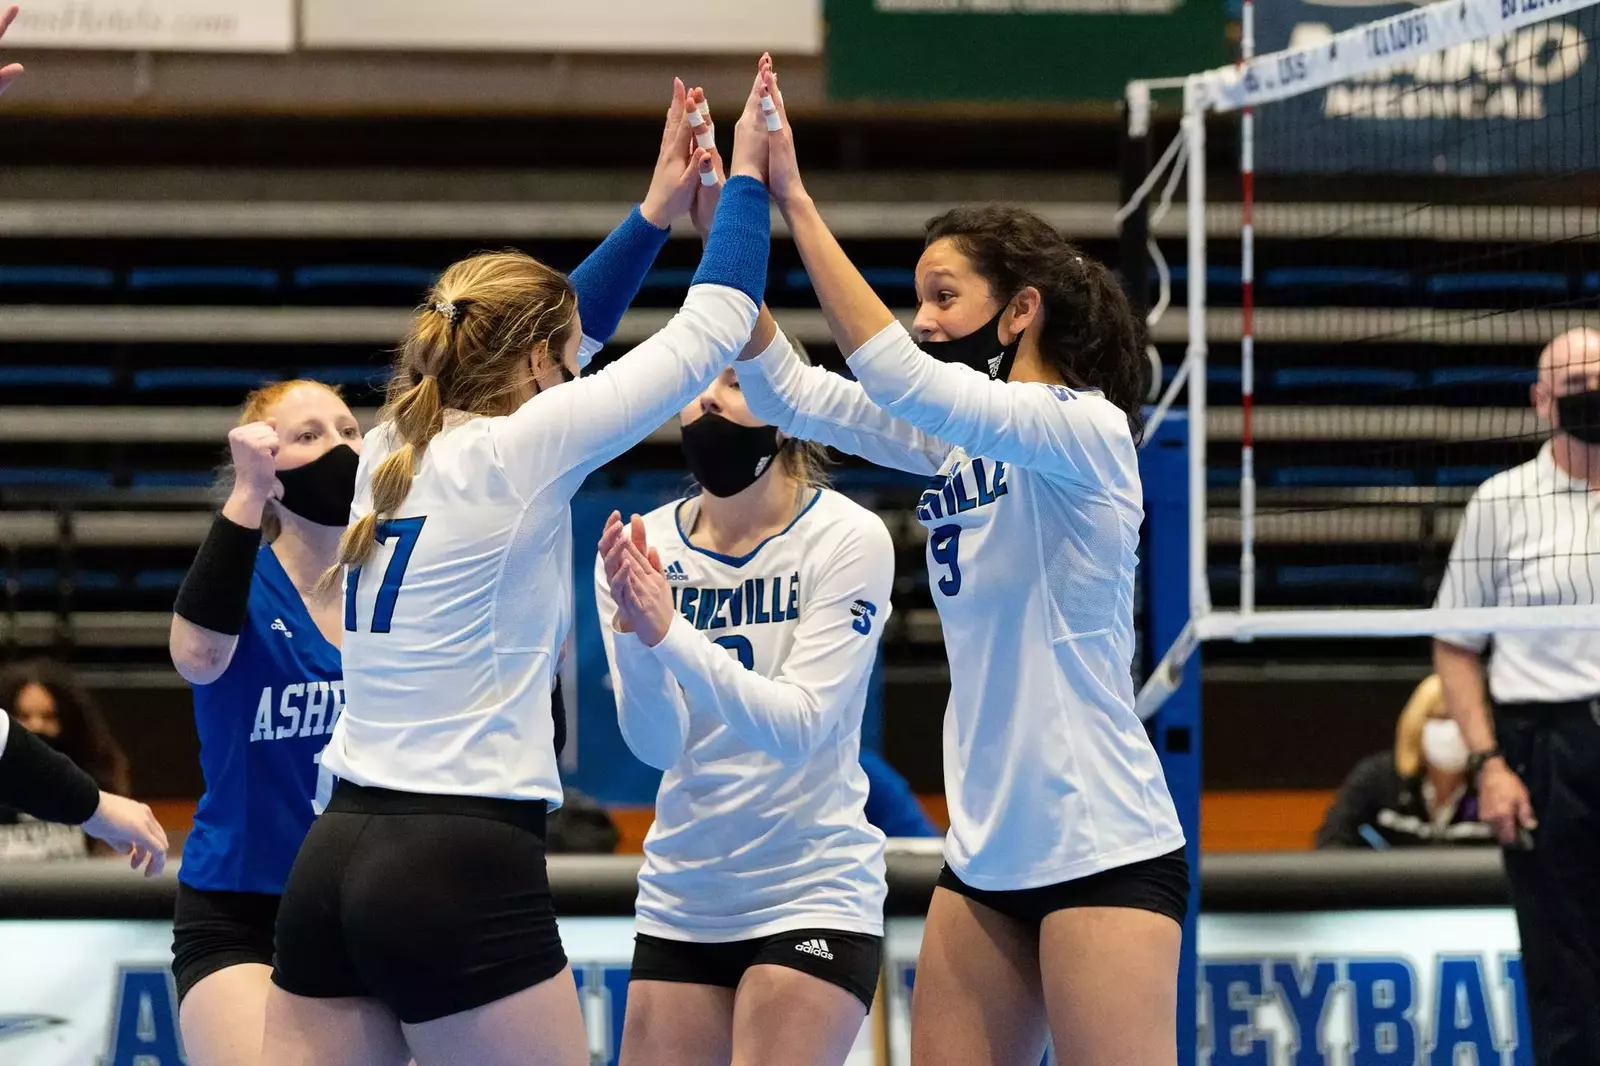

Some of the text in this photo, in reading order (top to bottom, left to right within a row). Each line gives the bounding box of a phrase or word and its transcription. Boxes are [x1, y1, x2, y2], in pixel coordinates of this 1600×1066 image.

[344, 515, 428, 634] 17
[930, 523, 963, 597] 9
[794, 943, 834, 960] adidas
